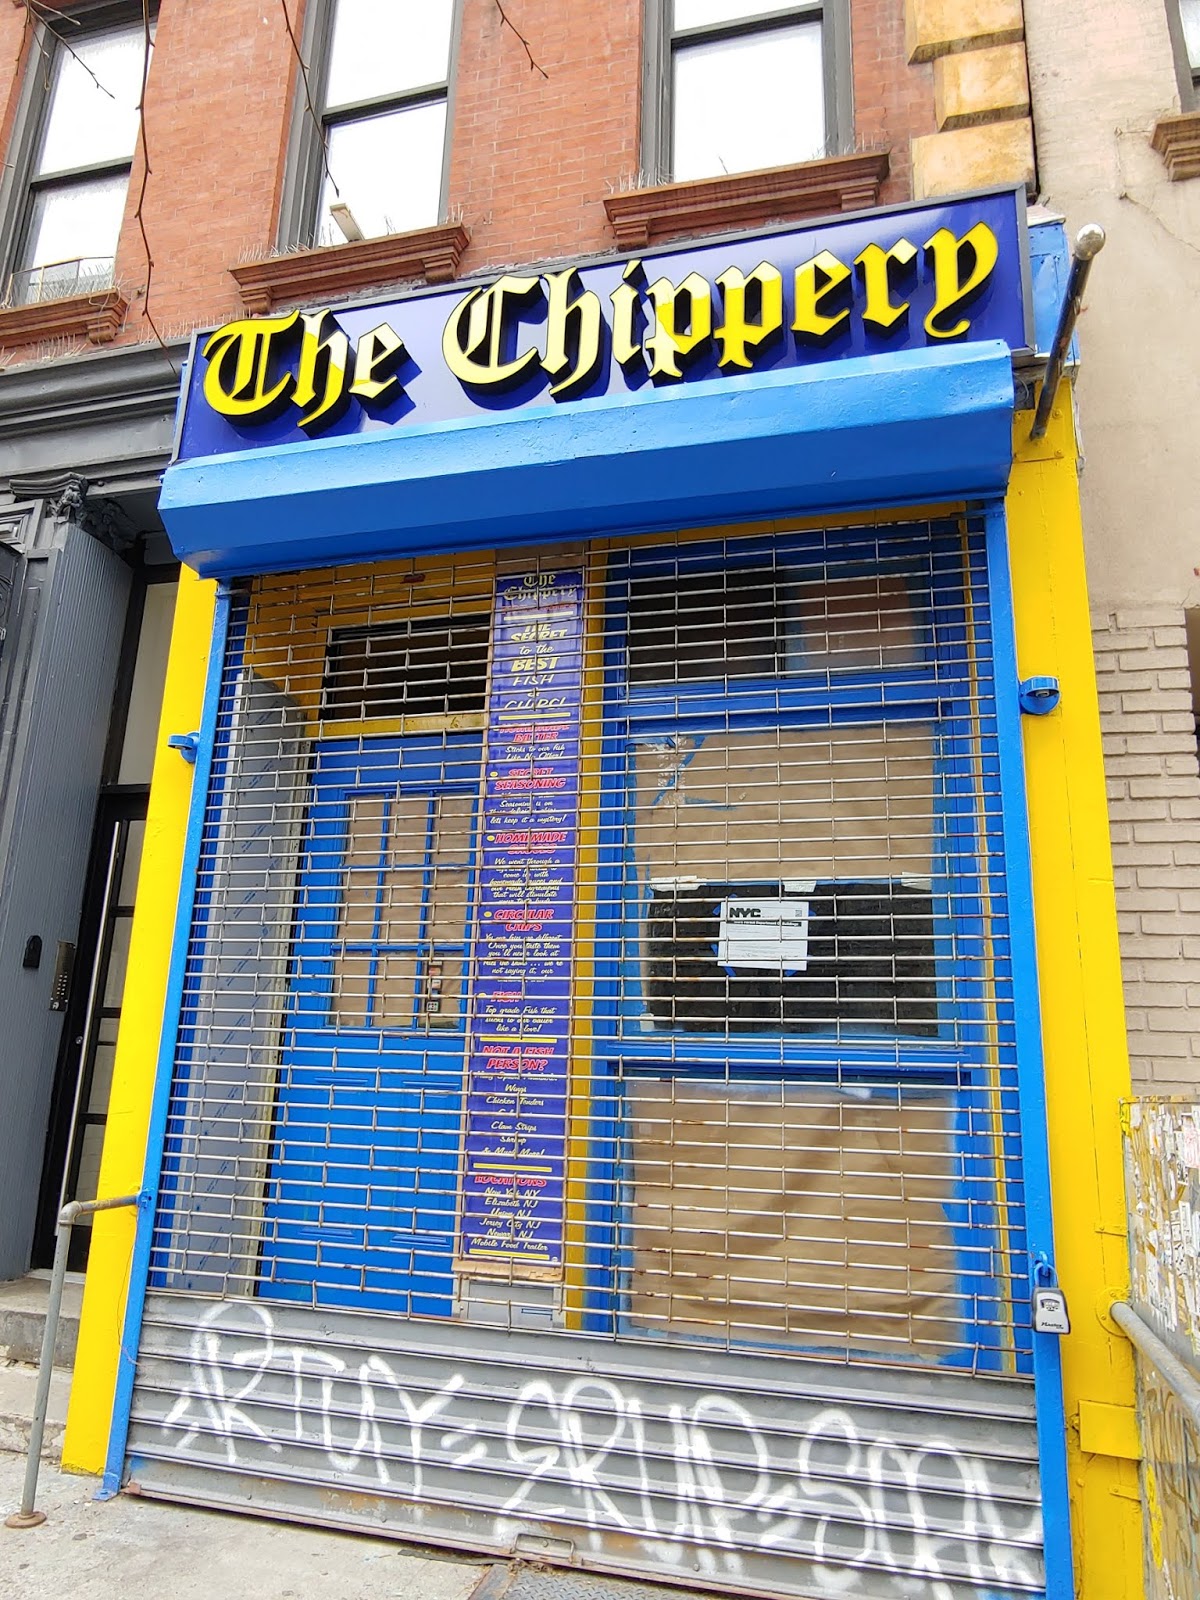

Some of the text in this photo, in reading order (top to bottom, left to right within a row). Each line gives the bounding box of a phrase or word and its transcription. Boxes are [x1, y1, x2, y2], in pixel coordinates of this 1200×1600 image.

[200, 219, 1001, 430] The Chippery
[523, 574, 556, 587] The
[519, 643, 554, 655] to the
[511, 657, 560, 672] BEST
[494, 778, 567, 791] SEASONING
[729, 907, 761, 918] NYC
[483, 1046, 511, 1055] NOT
[486, 1058, 549, 1071] PERSON?
[500, 1136, 526, 1145] Shrmp
[505, 1188, 520, 1196] Yok
[523, 1200, 538, 1208] NJ
[506, 1220, 522, 1229] Cty
[525, 1221, 541, 1229] NJ
[487, 1228, 515, 1238] Newar
[471, 1238, 498, 1247] Mobile
[501, 1240, 519, 1249] Food
